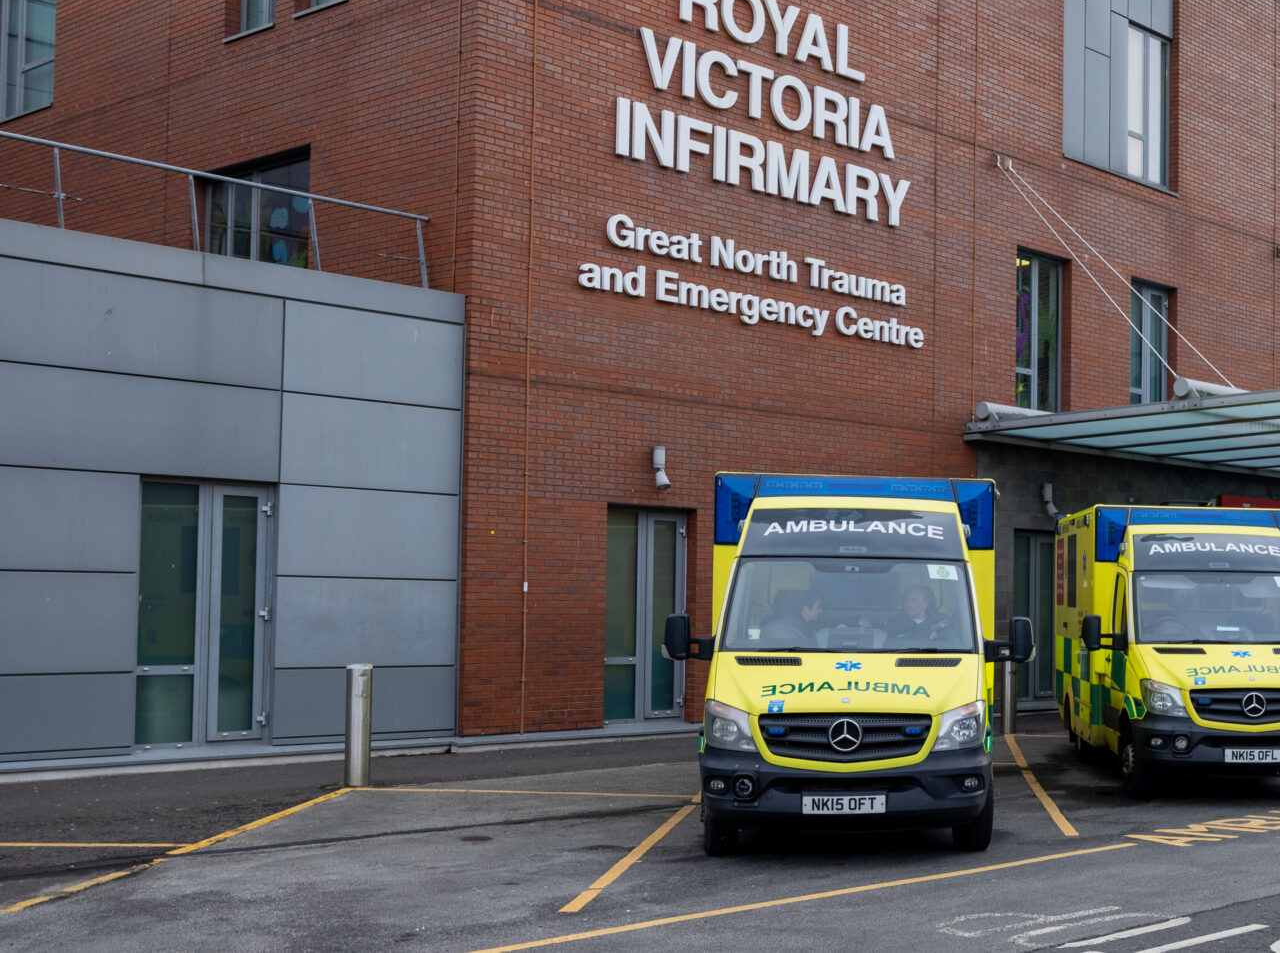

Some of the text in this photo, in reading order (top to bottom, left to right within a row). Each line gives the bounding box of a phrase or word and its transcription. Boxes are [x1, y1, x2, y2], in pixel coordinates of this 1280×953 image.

[639, 26, 896, 160] VICTORIA
[614, 96, 911, 228] INFIRMARY
[606, 213, 906, 306] Great North Trauma
[578, 261, 925, 349] and Emergency Centre
[763, 519, 945, 540] AMBULANCE
[1231, 750, 1278, 761] NK15 OFL
[811, 797, 877, 811] NK15 OFT
